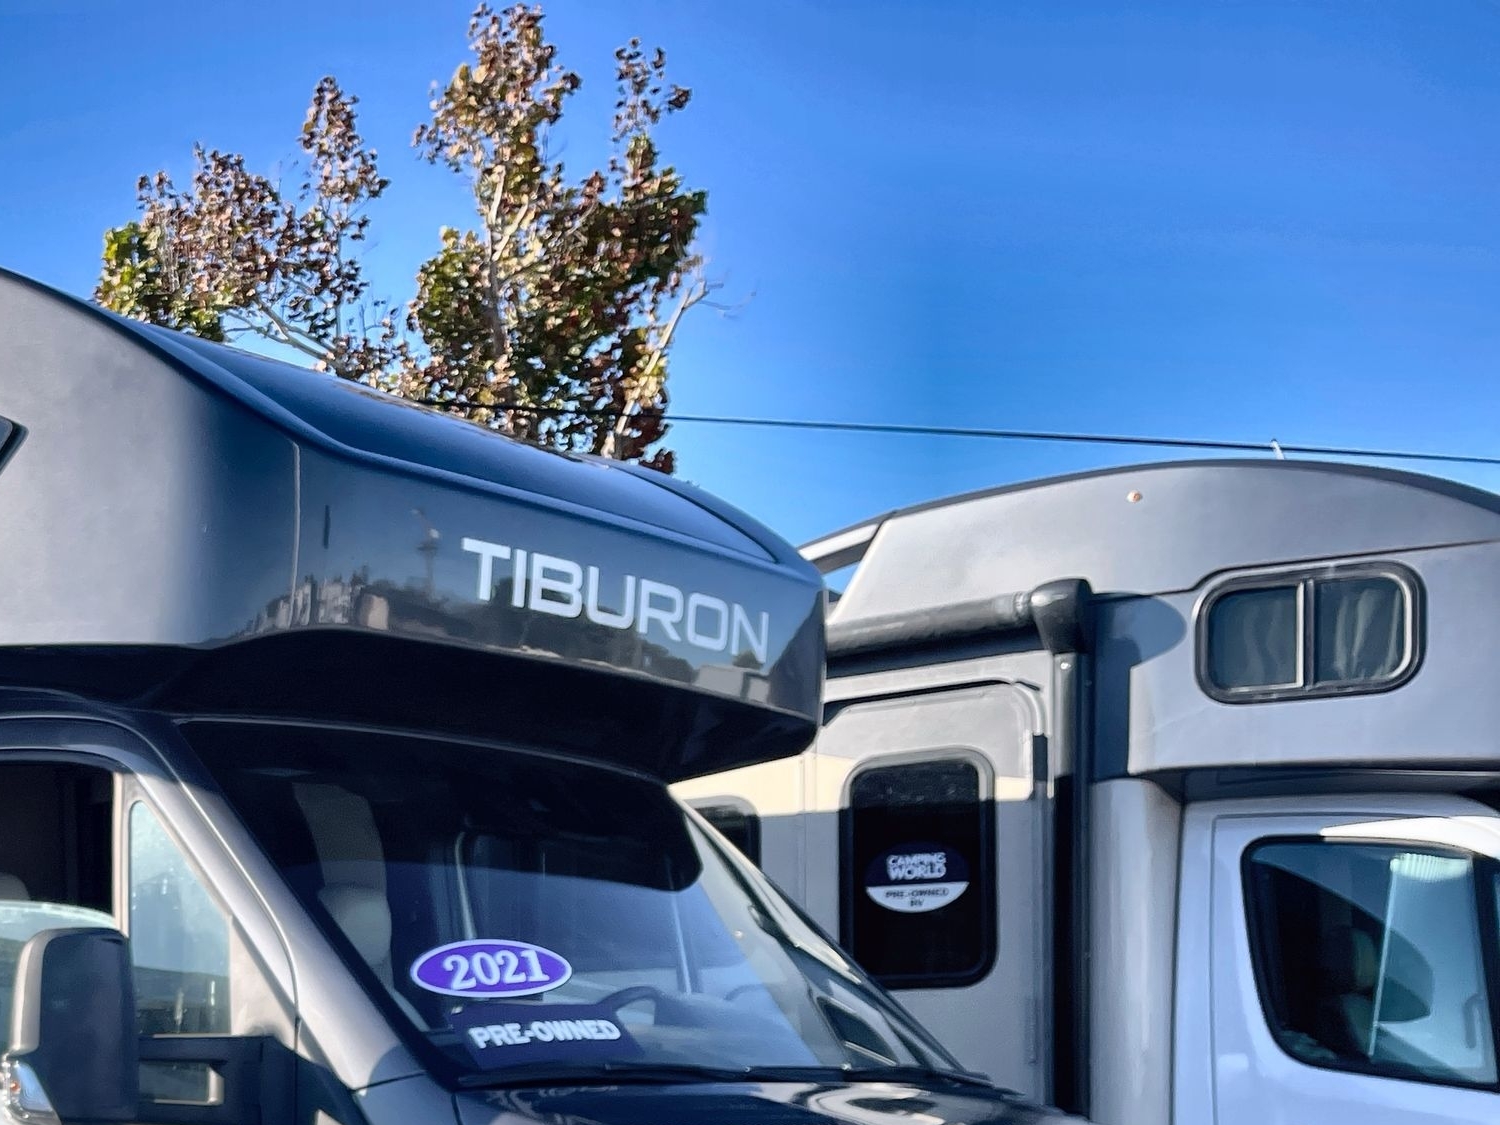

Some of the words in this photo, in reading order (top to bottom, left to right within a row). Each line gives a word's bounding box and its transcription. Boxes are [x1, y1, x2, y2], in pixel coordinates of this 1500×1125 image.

[461, 537, 770, 664] TIBURON
[887, 862, 947, 881] WORLD
[442, 949, 550, 991] 2021
[468, 1019, 622, 1049] PRE-OWNED
